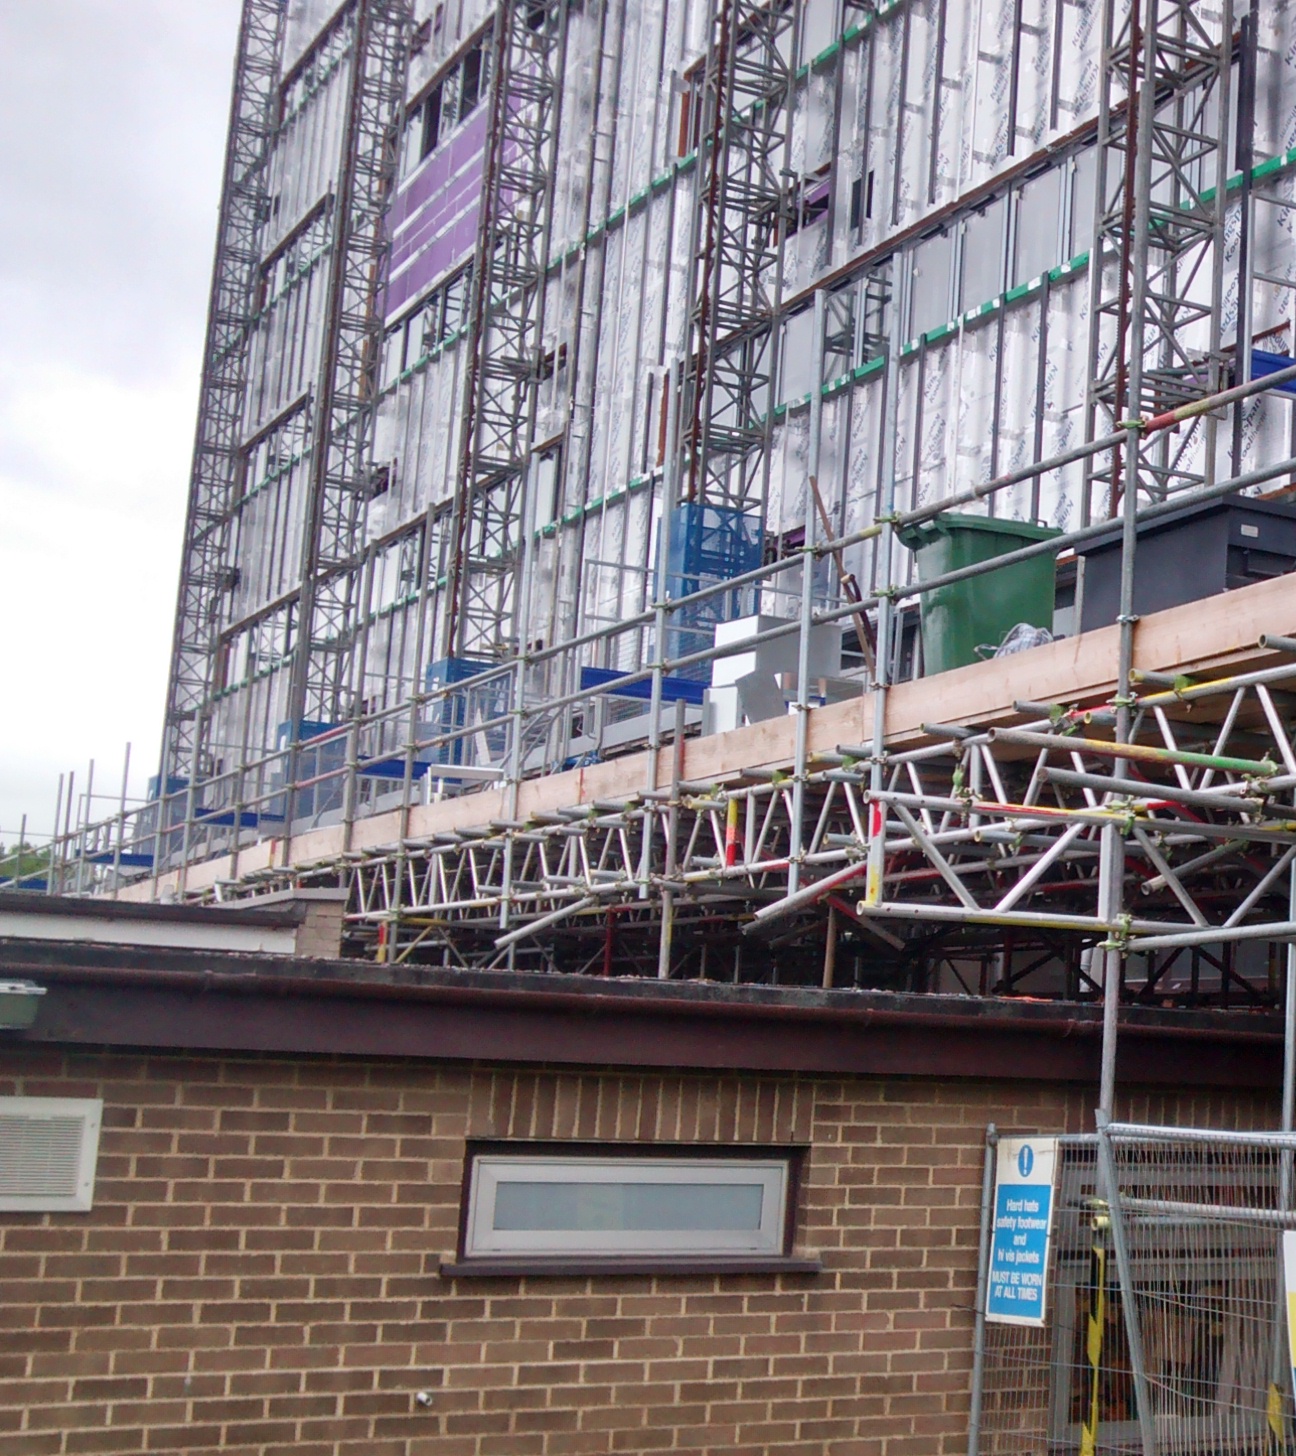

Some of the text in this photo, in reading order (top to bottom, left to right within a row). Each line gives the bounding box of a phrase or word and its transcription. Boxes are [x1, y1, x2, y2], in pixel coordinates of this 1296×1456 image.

[1006, 1199, 1039, 1212] Hard hats
[997, 1216, 1047, 1231] safety footwear
[1013, 1233, 1027, 1246] and
[998, 1248, 1039, 1265] hi vis jackets
[992, 1270, 1042, 1286] MUST BE WORN
[994, 1285, 1037, 1301] AT ALL TIMES
